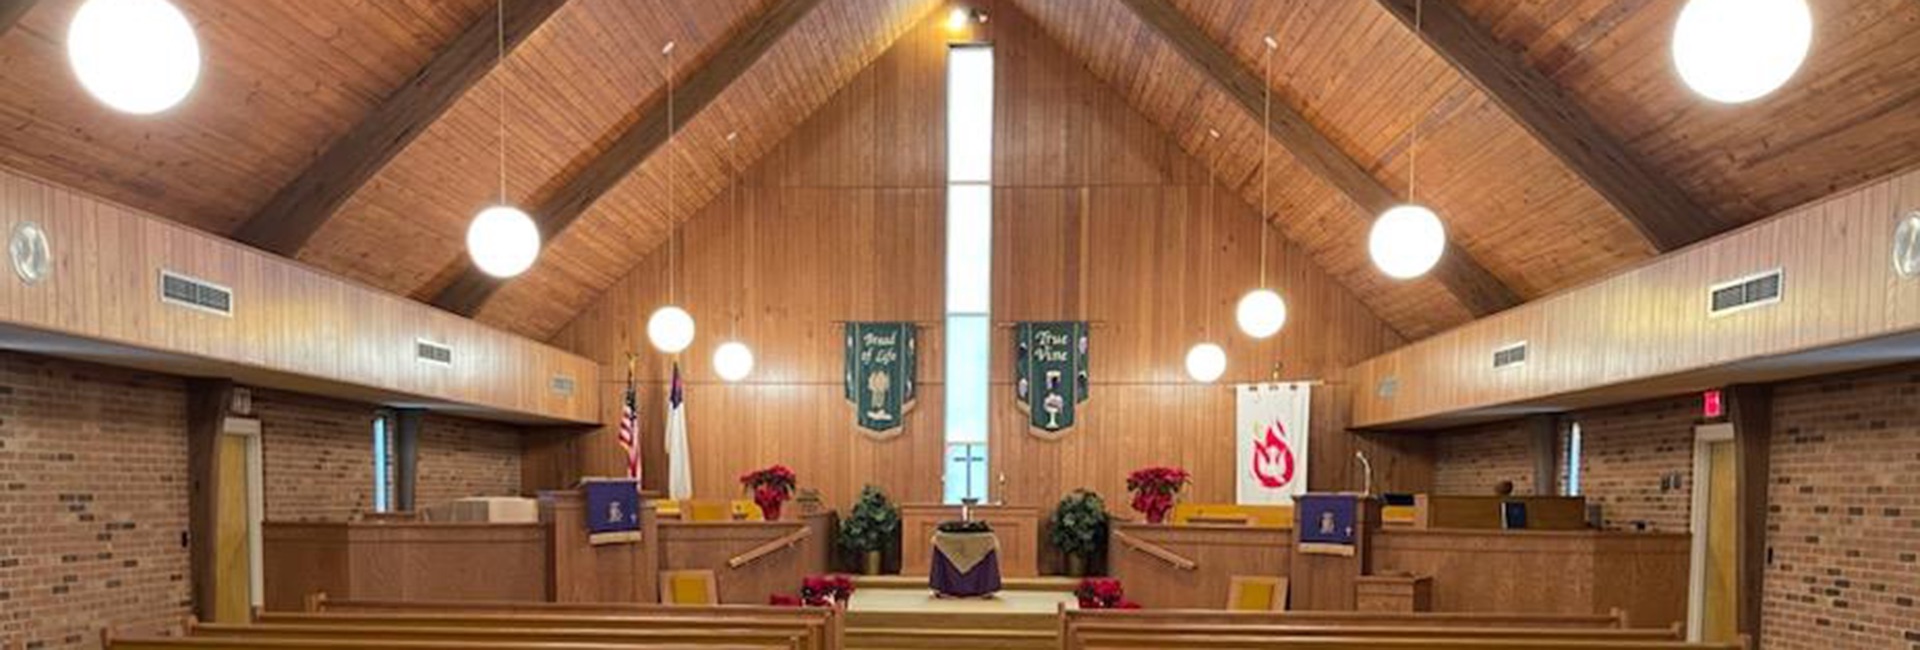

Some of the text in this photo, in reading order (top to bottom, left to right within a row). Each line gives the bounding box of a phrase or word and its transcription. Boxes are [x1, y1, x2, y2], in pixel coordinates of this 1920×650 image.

[1034, 330, 1067, 345] True
[861, 348, 898, 364] of Life
[1034, 346, 1067, 361] Vine
